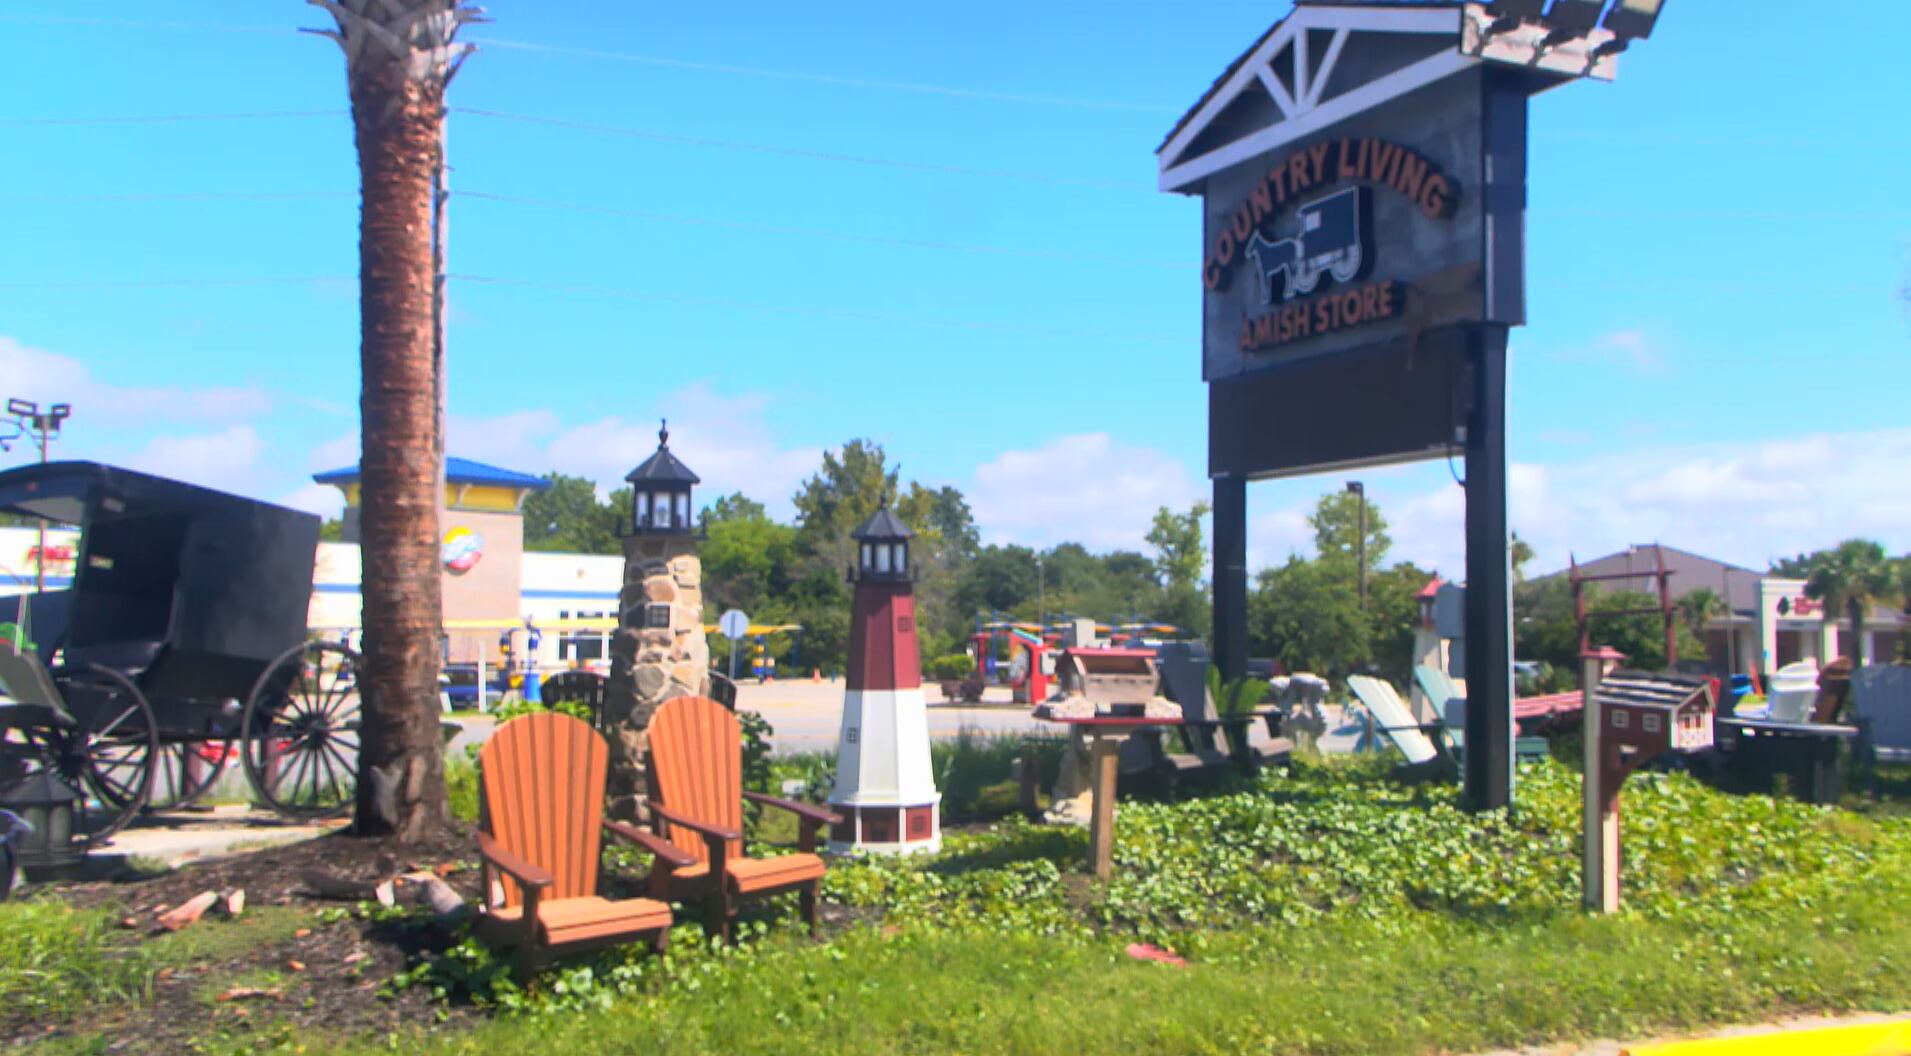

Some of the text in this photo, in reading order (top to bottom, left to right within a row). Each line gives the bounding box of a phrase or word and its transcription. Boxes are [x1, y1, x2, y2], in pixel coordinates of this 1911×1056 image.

[1204, 138, 1448, 290] COUNTRY LIVING
[1239, 281, 1393, 350] AMISH STORE
